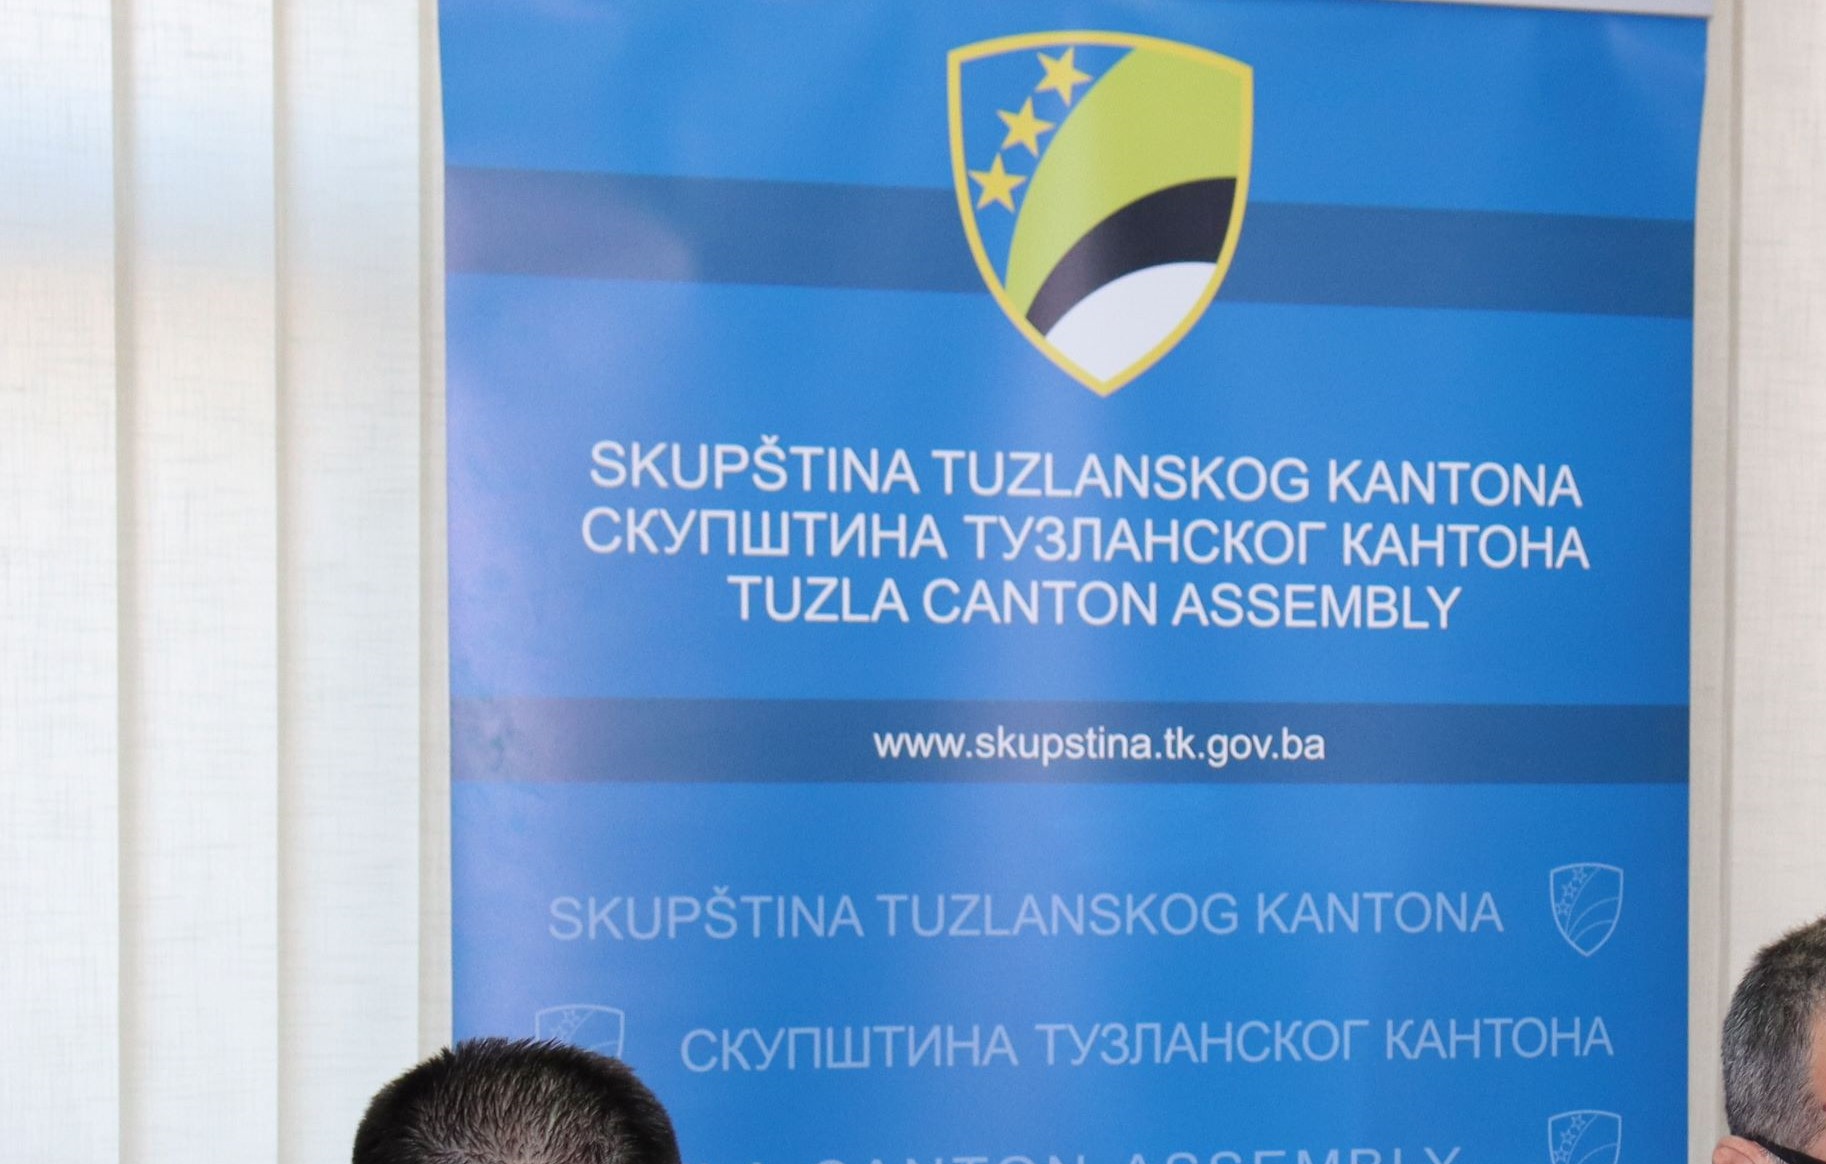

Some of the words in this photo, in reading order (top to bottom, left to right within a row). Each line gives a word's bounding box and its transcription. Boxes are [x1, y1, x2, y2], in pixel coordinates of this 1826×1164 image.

[591, 435, 920, 495] SKUPŠTINA
[931, 450, 1310, 503] TUZLANSKOG
[1329, 458, 1583, 508] KANTONA
[582, 508, 948, 559] СКУПШТИНА
[963, 515, 1328, 567] ТУЗЛАНСКОГ
[1344, 523, 1591, 569] КАНТОНА
[727, 576, 909, 623] TUZLA
[923, 577, 1158, 626] CANTON
[1172, 583, 1462, 630] ASSEMBLY
[873, 726, 1326, 769] www.skupstina.tk.gov.ba
[550, 886, 864, 940] SKUPŠTINA
[876, 892, 1239, 937] TUZLANSKOG
[1257, 891, 1504, 934] KANTONA
[680, 1024, 1018, 1074] СКУПШТИНА
[1035, 1019, 1369, 1066] ТУЗЛАНСКОГ
[1385, 1016, 1614, 1060] КАНТОНА
